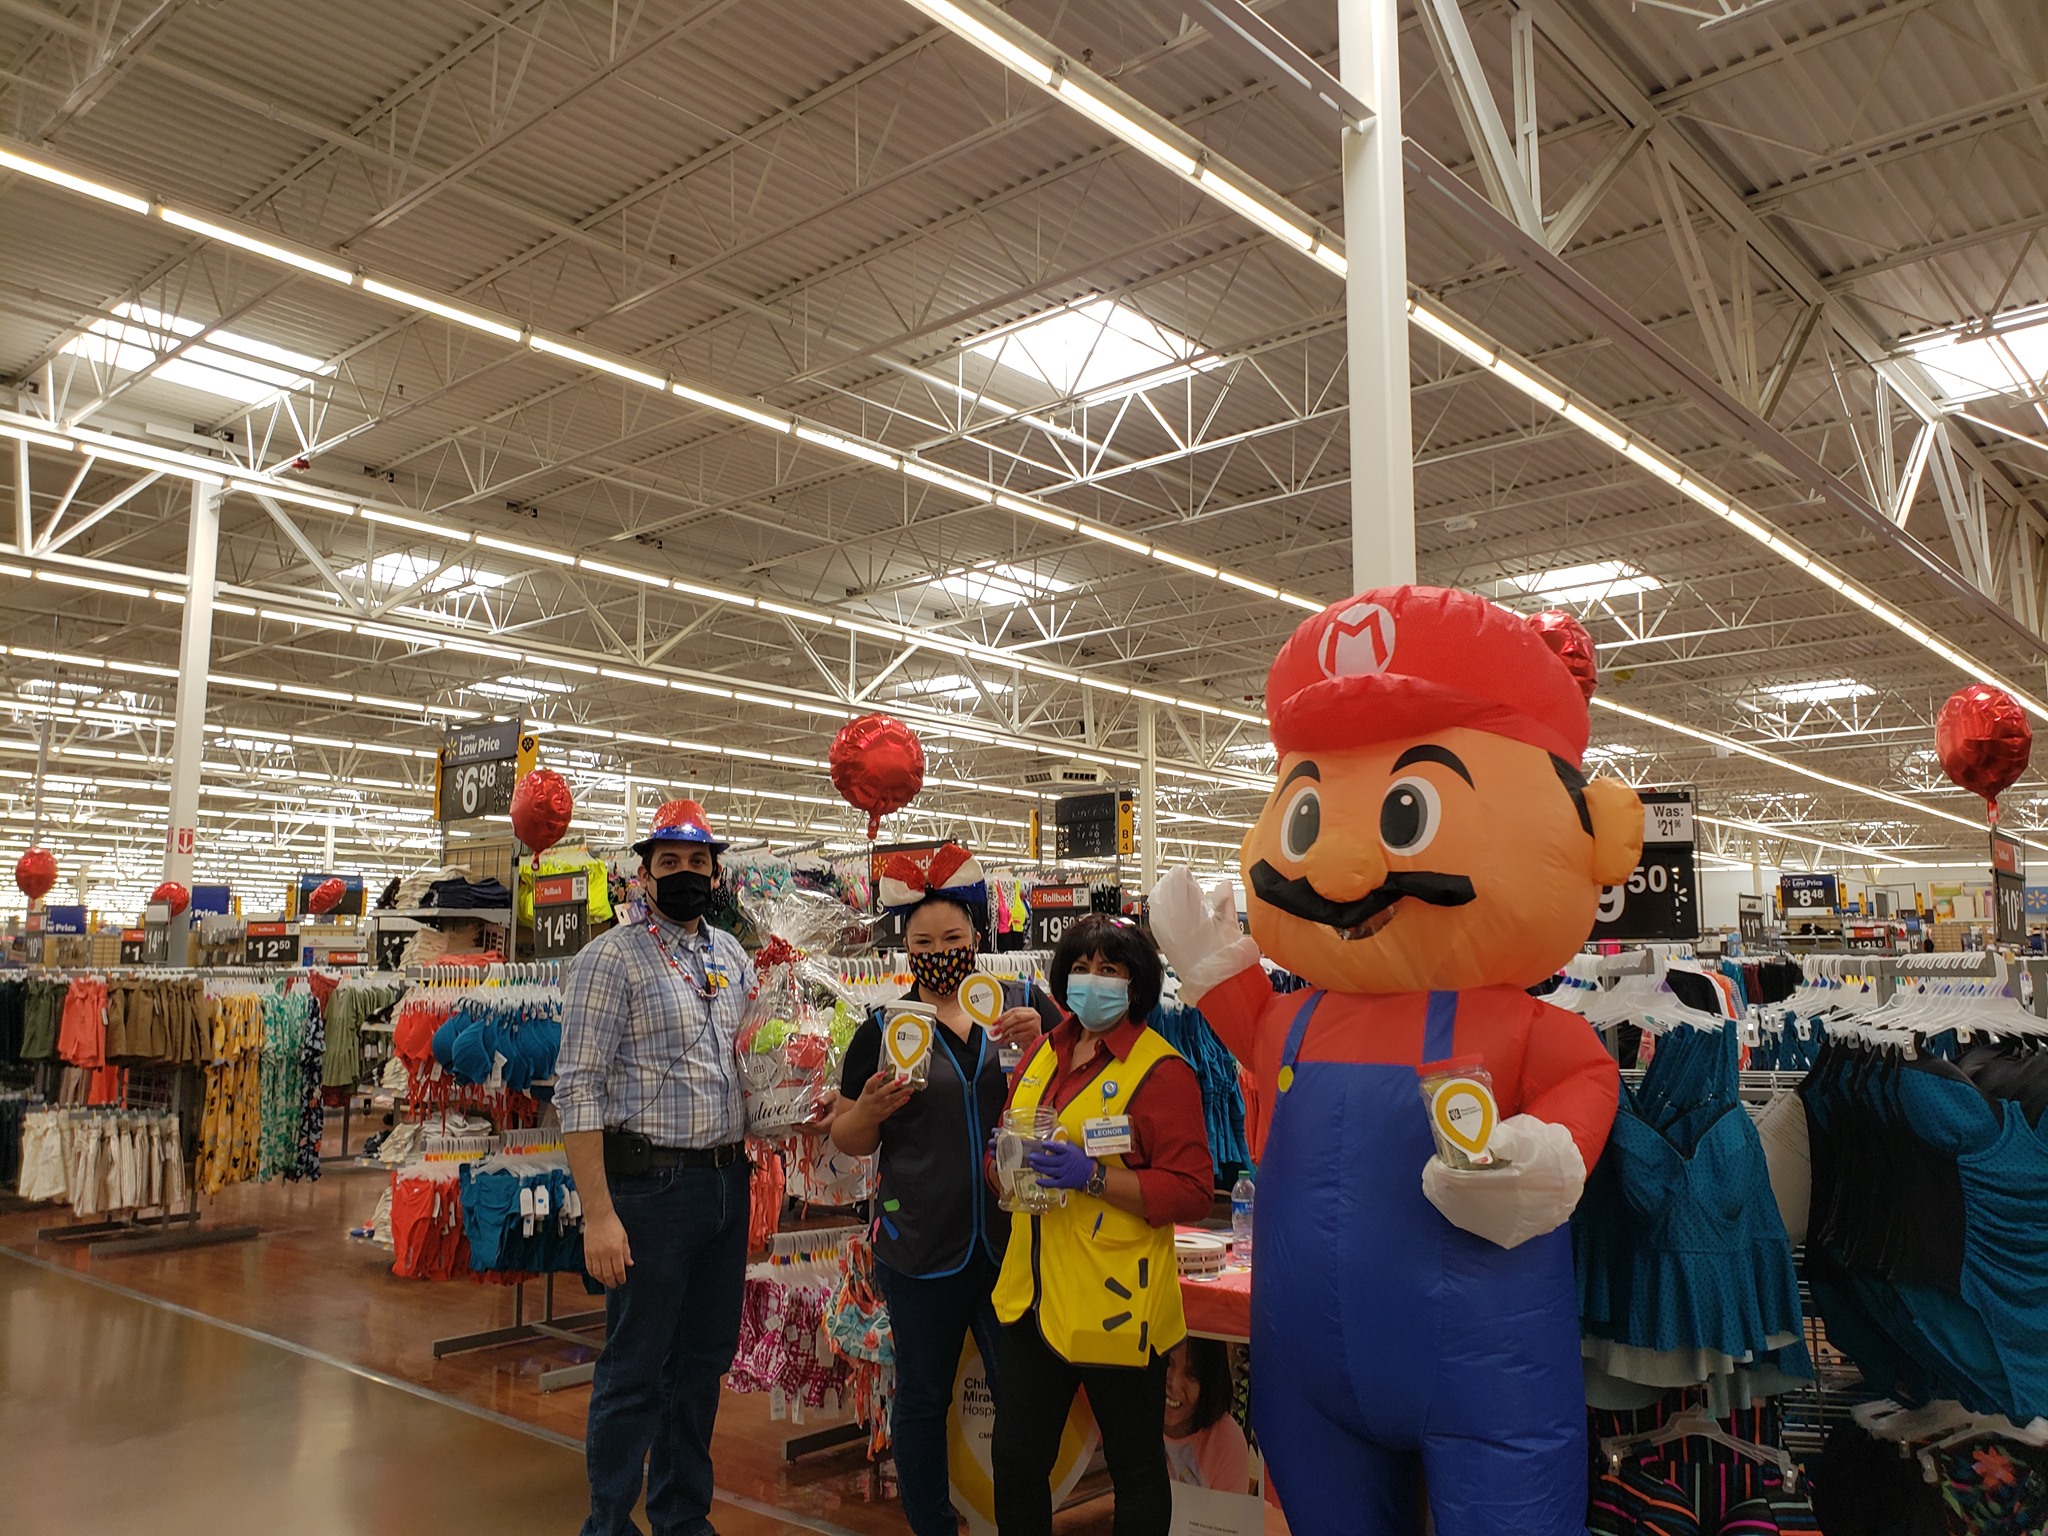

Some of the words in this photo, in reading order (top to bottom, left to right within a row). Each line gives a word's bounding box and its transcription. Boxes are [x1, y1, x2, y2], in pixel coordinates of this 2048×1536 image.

[1324, 609, 1389, 677] M
[459, 741, 478, 756] Low
[478, 736, 500, 754] Price
[1652, 805, 1684, 818] Was:
[1042, 893, 1073, 904] Rollback
[1093, 1127, 1123, 1138] LEONOR
[963, 1390, 990, 1403] Mira
